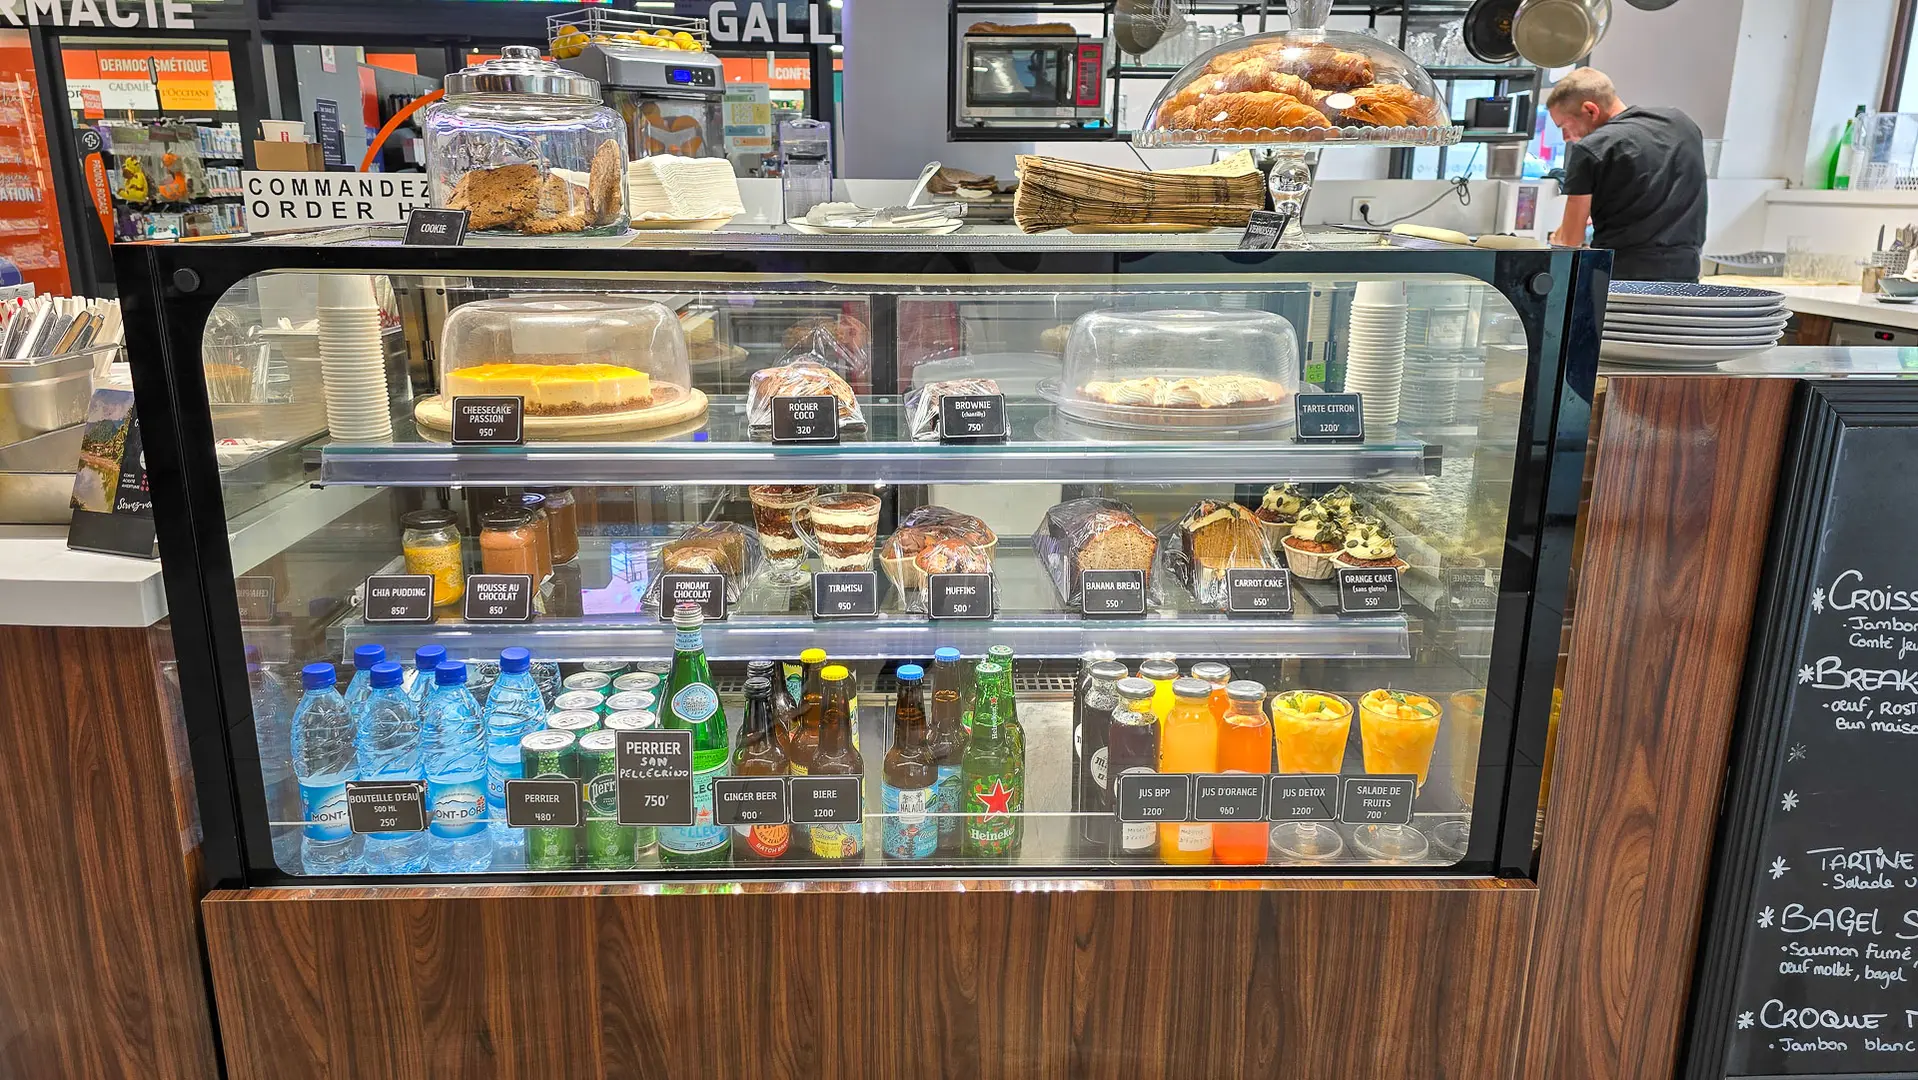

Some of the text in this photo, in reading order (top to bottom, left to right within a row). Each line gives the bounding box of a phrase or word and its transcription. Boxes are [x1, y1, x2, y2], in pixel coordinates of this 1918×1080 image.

[709, 1, 836, 43] GALL
[101, 57, 208, 73] DERMOCSMÉTIQUE
[249, 178, 428, 197] COMMANDEZ
[252, 200, 374, 219] ORDER
[420, 223, 447, 234] COOKIE
[789, 403, 819, 412] ROCHER
[955, 401, 991, 409] BROWNIE
[1303, 404, 1355, 413] TARTE CITRON
[462, 406, 511, 415] CHEESECAKE
[469, 415, 504, 423] PASSION
[794, 412, 815, 420] COCO
[1234, 579, 1283, 588] CARROT CAKE
[1345, 575, 1394, 583] ORANGE CAKE
[477, 583, 520, 592] MOUSSE AU
[676, 582, 710, 590] FONDANT
[829, 584, 863, 593] TIRAMISU
[1086, 581, 1141, 590] BANANA BREAD
[1352, 585, 1388, 593] (sans gluten)
[372, 588, 426, 597] CHIA PUDDING
[673, 590, 712, 598] CHOCOLAT
[945, 586, 976, 595] MUFFINS
[479, 592, 517, 601] CHOCOLAT
[626, 741, 681, 755] PERRIER
[813, 790, 837, 799] BIERE
[1139, 788, 1171, 798] JUS BPP
[1202, 788, 1257, 798] JUS D'ORANGE
[1282, 788, 1326, 799] JUS DETOX
[1357, 786, 1401, 795] SALADE DE
[350, 793, 418, 804] BOUTEILLE D'EAU
[525, 794, 560, 803] PERRIER
[724, 792, 777, 801] GINGER BEER
[1363, 799, 1392, 807] FRUITS
[312, 811, 348, 822] MONT-
[971, 825, 1015, 840] Heineke
[1789, 941, 1859, 957] Saumon
[1864, 964, 1908, 989] bagel
[1779, 1036, 1916, 1051] Jambon blanc
